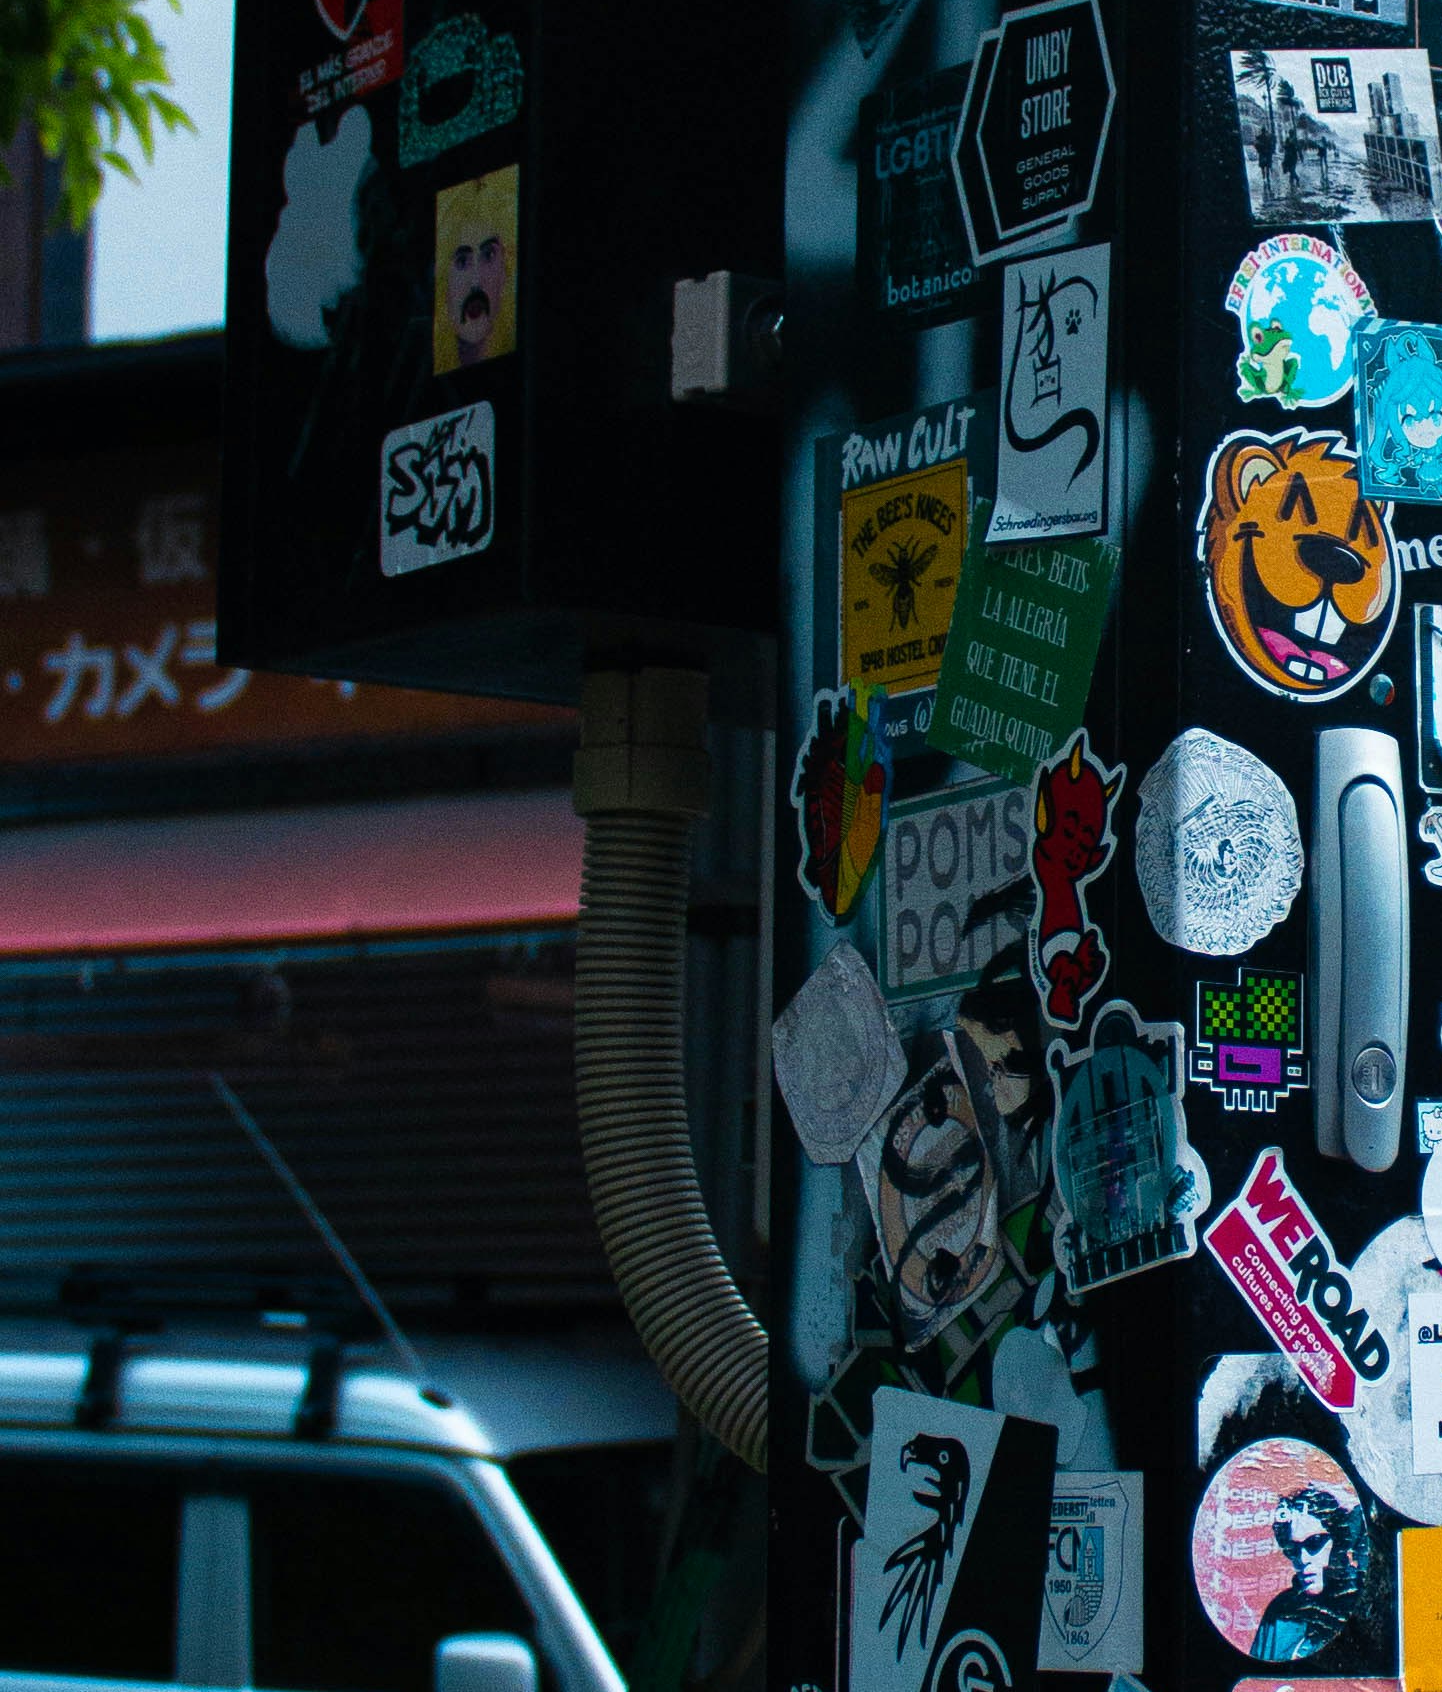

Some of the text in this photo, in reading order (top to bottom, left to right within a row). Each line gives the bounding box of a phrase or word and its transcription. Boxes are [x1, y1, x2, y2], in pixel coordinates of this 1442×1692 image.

[1025, 26, 1074, 85] UNBY
[1317, 62, 1350, 88] DUB
[1020, 85, 1074, 141] STORE
[1015, 144, 1077, 175] GENERAL
[1023, 165, 1071, 191] GOODS
[1021, 182, 1072, 211] SUPPLY
[886, 263, 973, 307] botanico
[840, 402, 977, 493] RAW CULT
[894, 789, 1030, 903] POMS
[1231, 1256, 1276, 1313] cultures
[1271, 1311, 1296, 1341] and
[1243, 1242, 1338, 1378] Connecting people,
[1048, 1578, 1072, 1595] 1950
[1064, 1629, 1091, 1647] 1862
